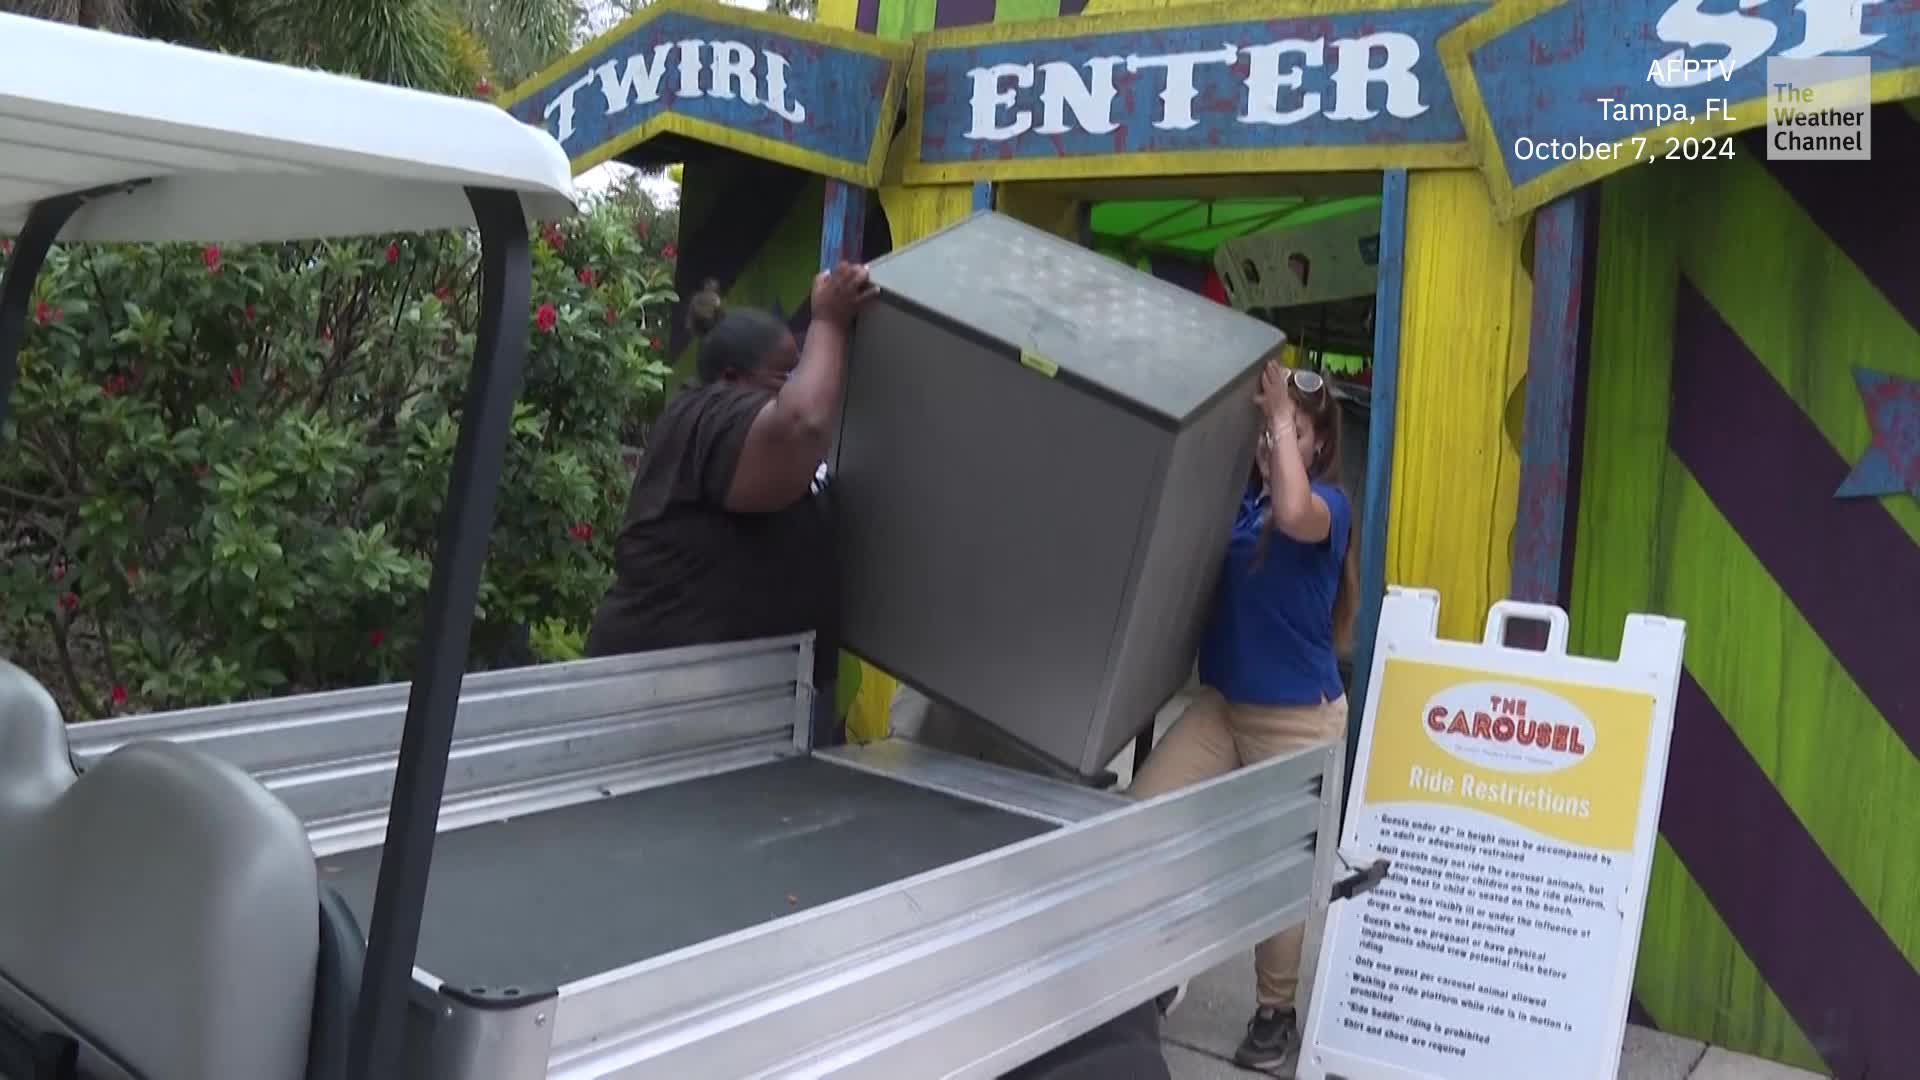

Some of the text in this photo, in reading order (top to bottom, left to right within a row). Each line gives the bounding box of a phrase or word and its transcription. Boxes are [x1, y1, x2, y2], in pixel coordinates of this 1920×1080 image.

[544, 39, 806, 144] TWIRL
[963, 31, 1429, 141] ENTER
[1490, 695, 1527, 716] THE
[1427, 706, 1585, 755] CAROUSEL
[1409, 765, 1590, 817] Ride Restrictions
[1380, 828, 1390, 836] an
[1393, 831, 1414, 841] adult
[1428, 837, 1476, 855] adequately
[1479, 847, 1525, 862] restrained
[1381, 813, 1409, 828] Guests
[1412, 821, 1436, 831] under
[1457, 829, 1465, 838] in
[1468, 830, 1495, 843] height
[1498, 837, 1520, 847] must
[1522, 840, 1534, 850] be
[1536, 845, 1598, 862] accompanied
[1601, 853, 1611, 866] by
[1376, 843, 1398, 855] Adult
[1400, 849, 1428, 860] guests
[1431, 856, 1448, 866] may
[1451, 860, 1465, 868] not
[1467, 863, 1485, 872] ride
[1488, 865, 1502, 875] the
[1505, 870, 1544, 883] carousel
[1589, 883, 1604, 895] but
[1386, 872, 1408, 885] nding
[1411, 878, 1429, 888] next
[1432, 881, 1440, 890] to
[1443, 884, 1465, 895] child
[1467, 888, 1476, 896] or
[1479, 891, 1509, 904] seated
[1512, 898, 1522, 907] on
[1526, 899, 1540, 910] the
[1394, 861, 1442, 878] accompany
[1445, 871, 1470, 881] minor
[1472, 875, 1508, 889] children
[1511, 884, 1522, 893] on
[1526, 885, 1540, 896] the
[1543, 890, 1560, 900] ride
[1363, 913, 1391, 928] Guests
[1394, 922, 1411, 931] who
[1413, 927, 1427, 935] are
[1430, 930, 1469, 945] pregnant
[1484, 940, 1505, 952] have
[1508, 946, 1546, 961] physical
[1367, 898, 1390, 912] drugs
[1404, 906, 1436, 920] alcohol
[1438, 914, 1452, 923] are
[1455, 918, 1469, 927] not
[1472, 921, 1515, 937] permitted
[1399, 893, 1416, 902] who
[1419, 898, 1433, 906] are
[1435, 899, 1462, 912] visibly
[1465, 904, 1474, 915] ill
[1488, 912, 1514, 923] under
[1517, 916, 1531, 926] the
[1535, 919, 1578, 936] influence
[1581, 929, 1591, 938] of
[1359, 940, 1383, 954] riding
[1361, 927, 1567, 979] impairments should view potential risks before
[1350, 987, 1393, 1003] prohibited
[1352, 971, 1572, 1032] Walking on ride platform while ride is in motion is
[1355, 955, 1547, 1008] Only one guest per carousel animal allowed
[1344, 1017, 1466, 1057] Shirt and shoes are required
[1406, 1017, 1431, 1032] riding
[1434, 1022, 1441, 1032] is
[1444, 1027, 1490, 1044] prohibited
